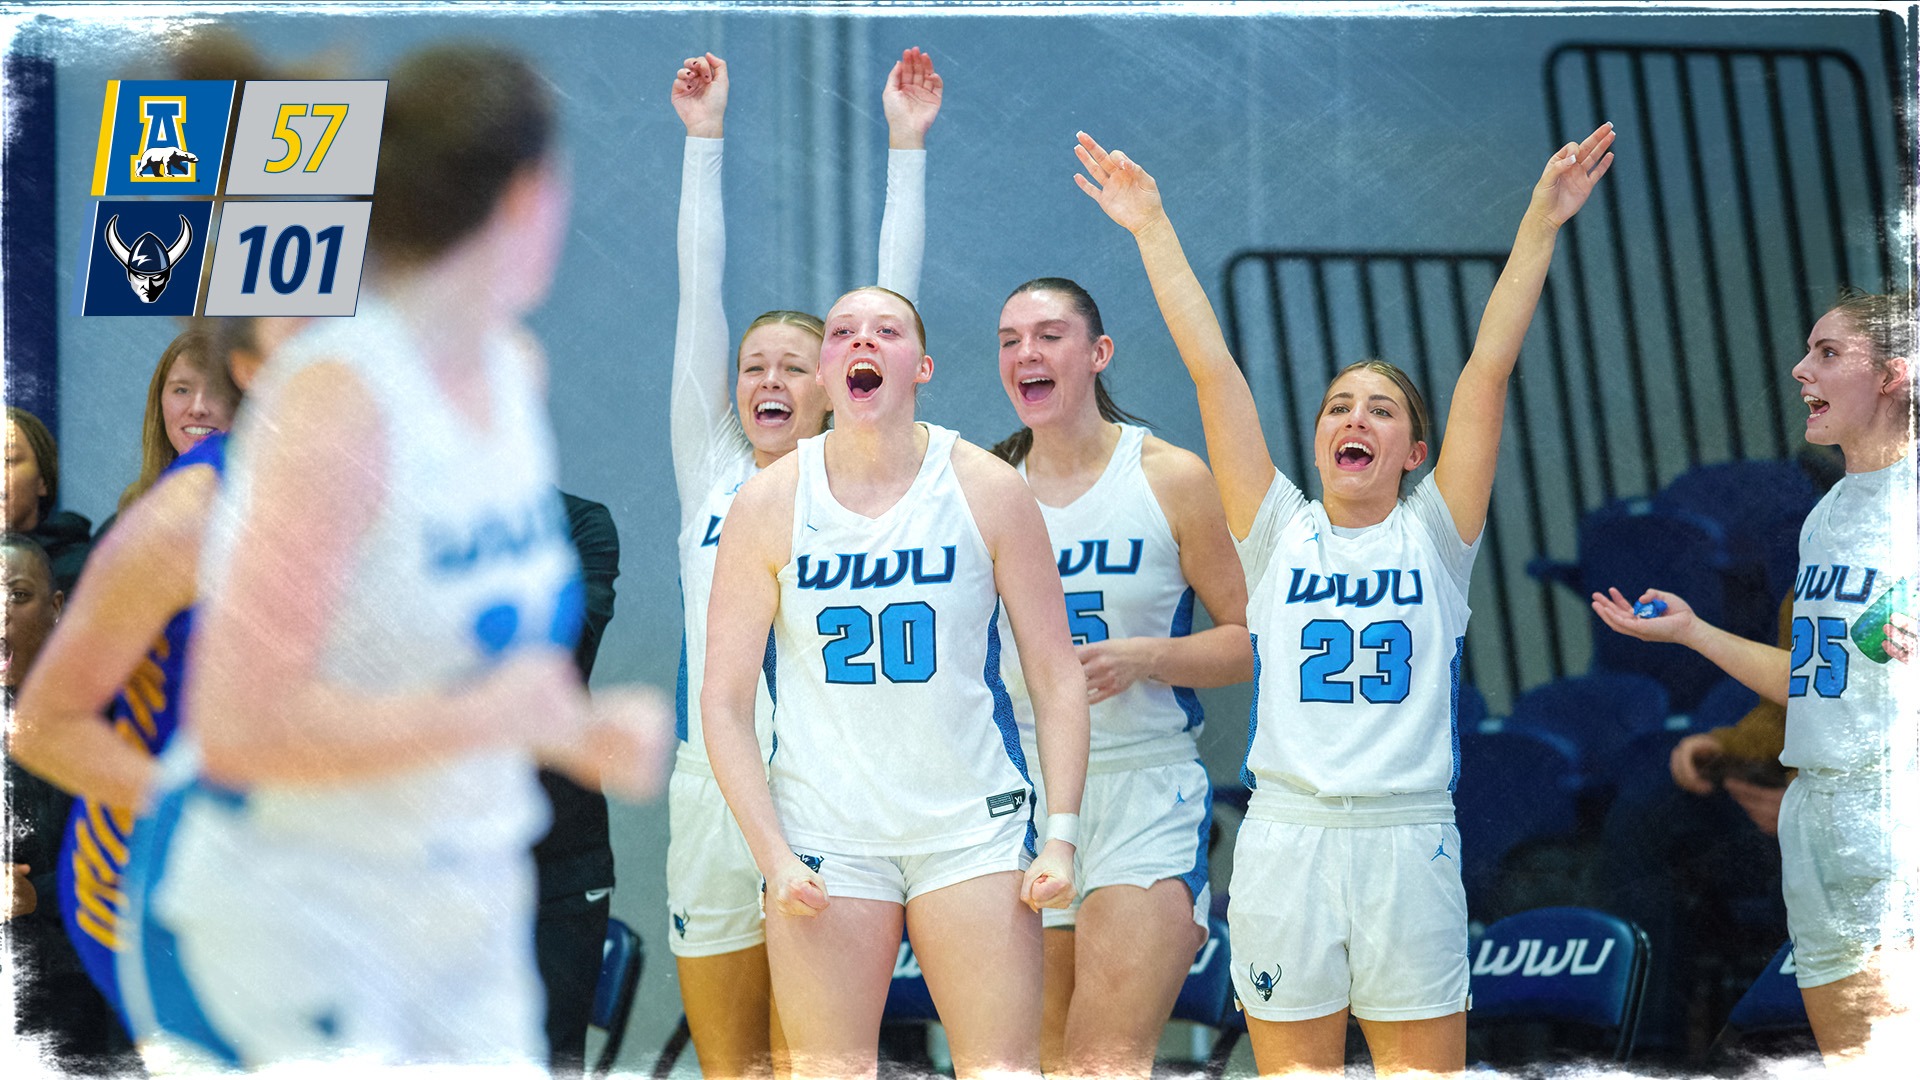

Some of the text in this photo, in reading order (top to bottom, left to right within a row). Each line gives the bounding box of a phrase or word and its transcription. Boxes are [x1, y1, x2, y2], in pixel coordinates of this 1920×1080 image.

[797, 545, 956, 590] WWU
[1057, 538, 1144, 577] WU
[1284, 567, 1423, 608] WWU
[816, 601, 937, 685] 20
[1063, 590, 1110, 646] 5
[1299, 618, 1413, 704] 23
[1788, 616, 1849, 698] 25
[1471, 938, 1616, 977] WWU
